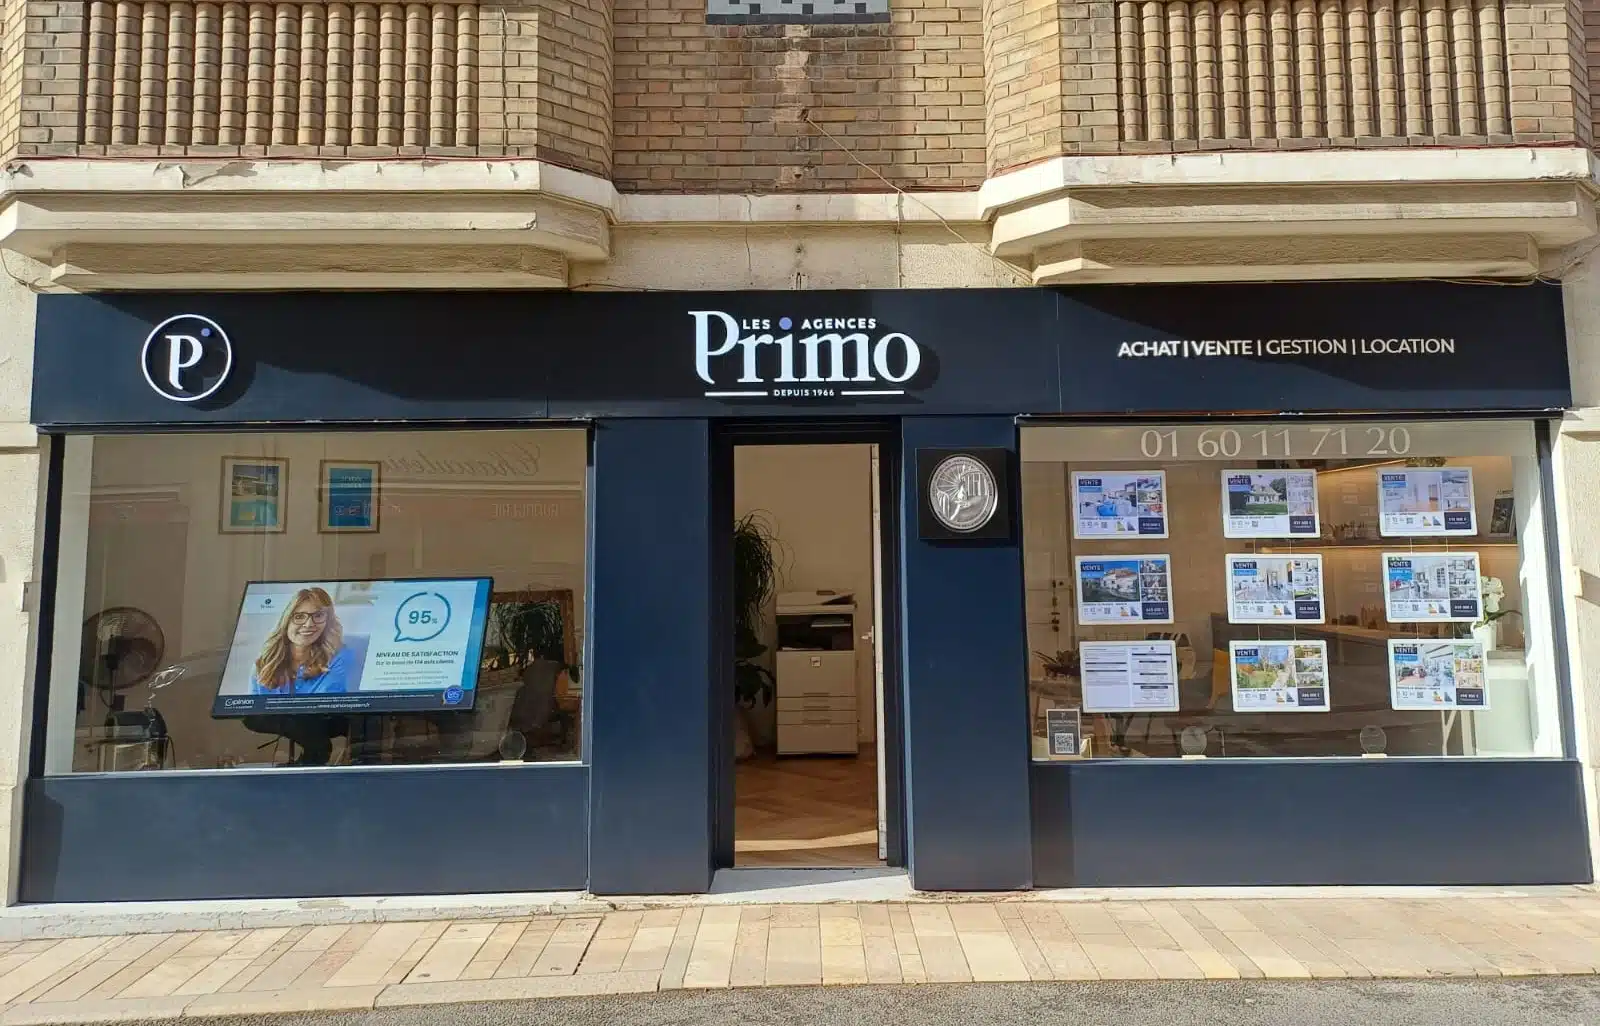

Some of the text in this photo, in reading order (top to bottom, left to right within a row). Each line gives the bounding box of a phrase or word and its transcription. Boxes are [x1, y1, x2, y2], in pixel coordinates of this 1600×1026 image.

[742, 317, 877, 330] LES AGENCES
[687, 310, 921, 385] Primo
[1117, 338, 1456, 358] ACHAT VENTE GESTION LOCATION
[165, 334, 204, 391] P
[773, 388, 835, 397] DEPUIS 1966
[1139, 426, 1411, 458] 01 60 11 71 20
